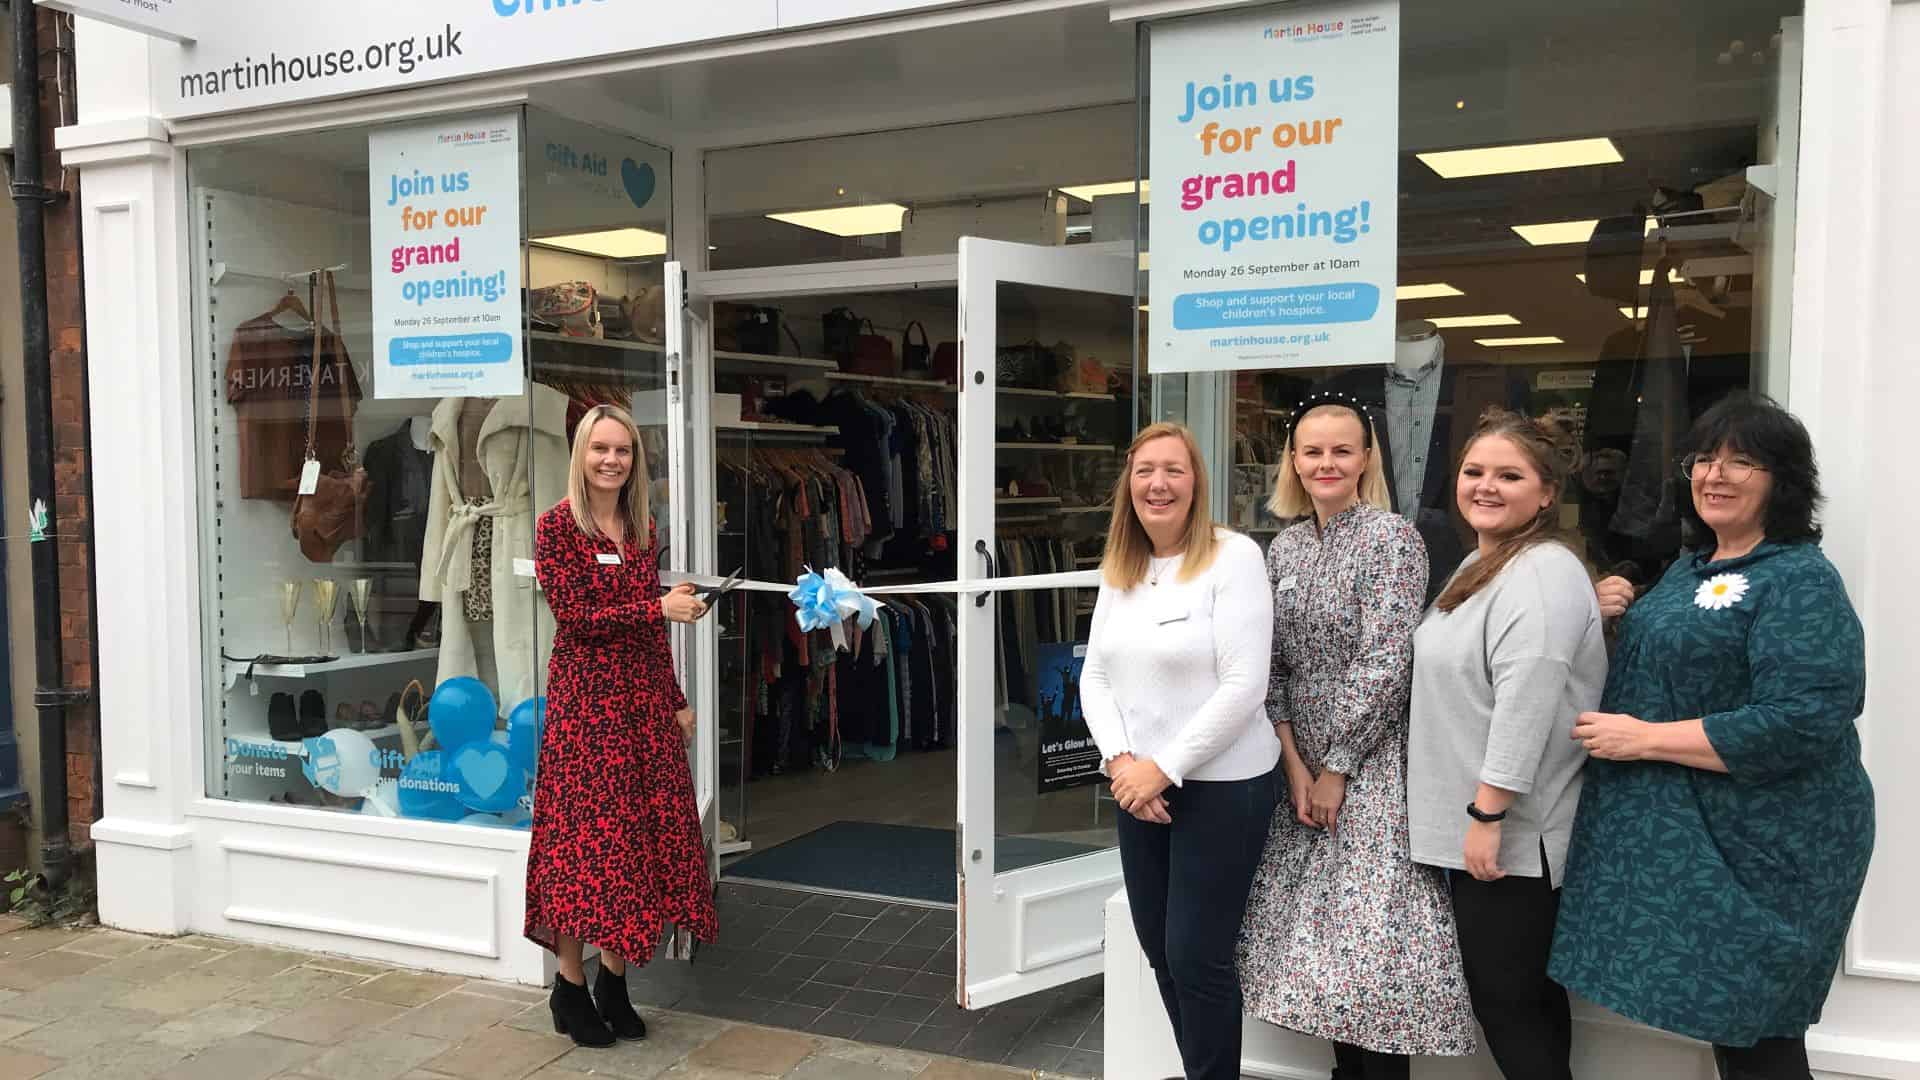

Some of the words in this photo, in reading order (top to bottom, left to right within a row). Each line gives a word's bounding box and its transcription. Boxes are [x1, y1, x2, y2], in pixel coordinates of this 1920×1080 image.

[1263, 24, 1303, 39] Martin
[1307, 20, 1344, 34] House
[180, 23, 463, 98] martinhouse.org.uk
[1177, 74, 1257, 123] Join
[1269, 75, 1314, 103] us
[1200, 122, 1262, 156] for
[1272, 118, 1342, 148] our
[387, 169, 434, 206] Join
[441, 172, 470, 193] us
[1181, 159, 1296, 211] grand
[401, 205, 438, 231] for
[444, 205, 487, 228] our
[1198, 200, 1370, 252] opening!
[391, 236, 460, 273] grand
[1183, 267, 1227, 280] Monday
[1230, 265, 1245, 276] 26
[1247, 262, 1309, 277] September
[1313, 262, 1325, 271] at
[1329, 258, 1360, 269] 10am
[402, 270, 506, 306] opening!
[1196, 297, 1223, 309] Shop
[1226, 295, 1247, 306] and
[1250, 292, 1295, 305] support
[1298, 292, 1324, 304] your
[1327, 288, 1356, 300] local
[394, 317, 421, 328] Monday
[433, 315, 471, 326] September
[1222, 306, 1276, 320] children's
[1209, 331, 1330, 348] martinhouse.org.uk
[227, 738, 288, 760] Donate
[369, 747, 406, 769] Gift
[1041, 743, 1063, 754] Let's
[1064, 740, 1085, 751] Glow
[255, 762, 286, 778] items
[399, 776, 460, 793] donations
